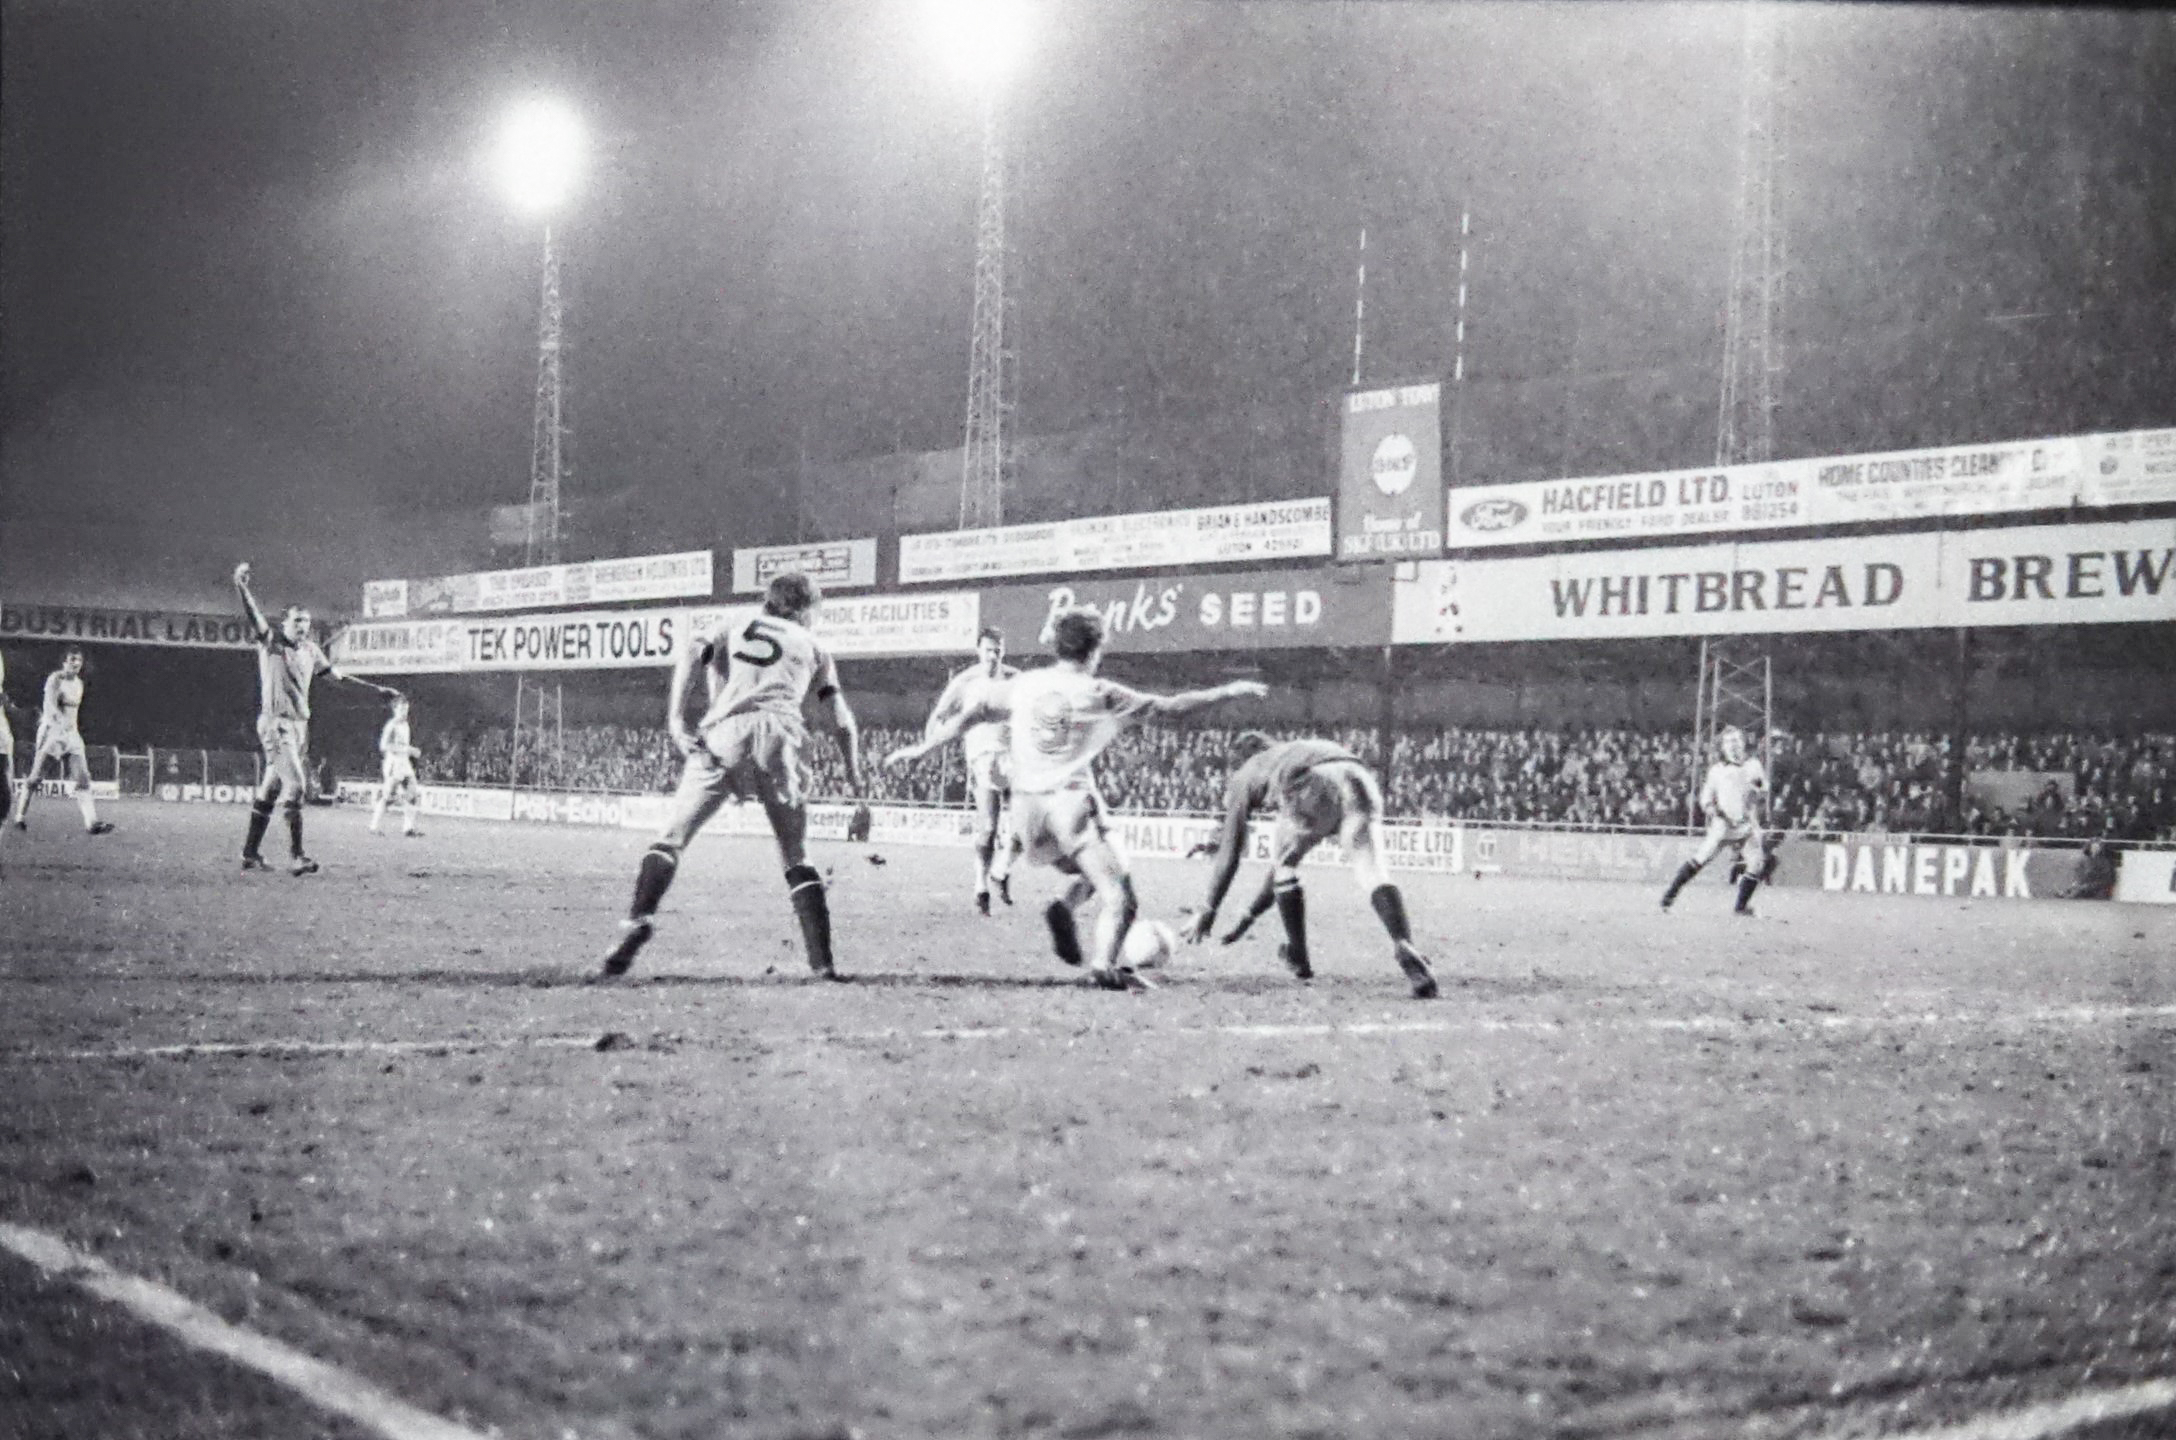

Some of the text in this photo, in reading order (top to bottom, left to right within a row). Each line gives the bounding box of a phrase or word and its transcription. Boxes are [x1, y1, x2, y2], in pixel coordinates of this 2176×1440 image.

[1867, 457, 1945, 484] COUNTIES
[1742, 481, 1800, 501] LUTON
[1550, 562, 1905, 618] WHITBREAD
[861, 600, 951, 623] FACILITIES
[1200, 591, 1322, 626] SEED
[468, 627, 511, 661] TEK
[514, 622, 592, 660] POWER
[600, 617, 674, 659] TOOLS
[733, 619, 787, 668] 5
[1124, 823, 1174, 851] HALL
[1425, 831, 1454, 854] LTD
[1823, 844, 2032, 898] DANEPAK
